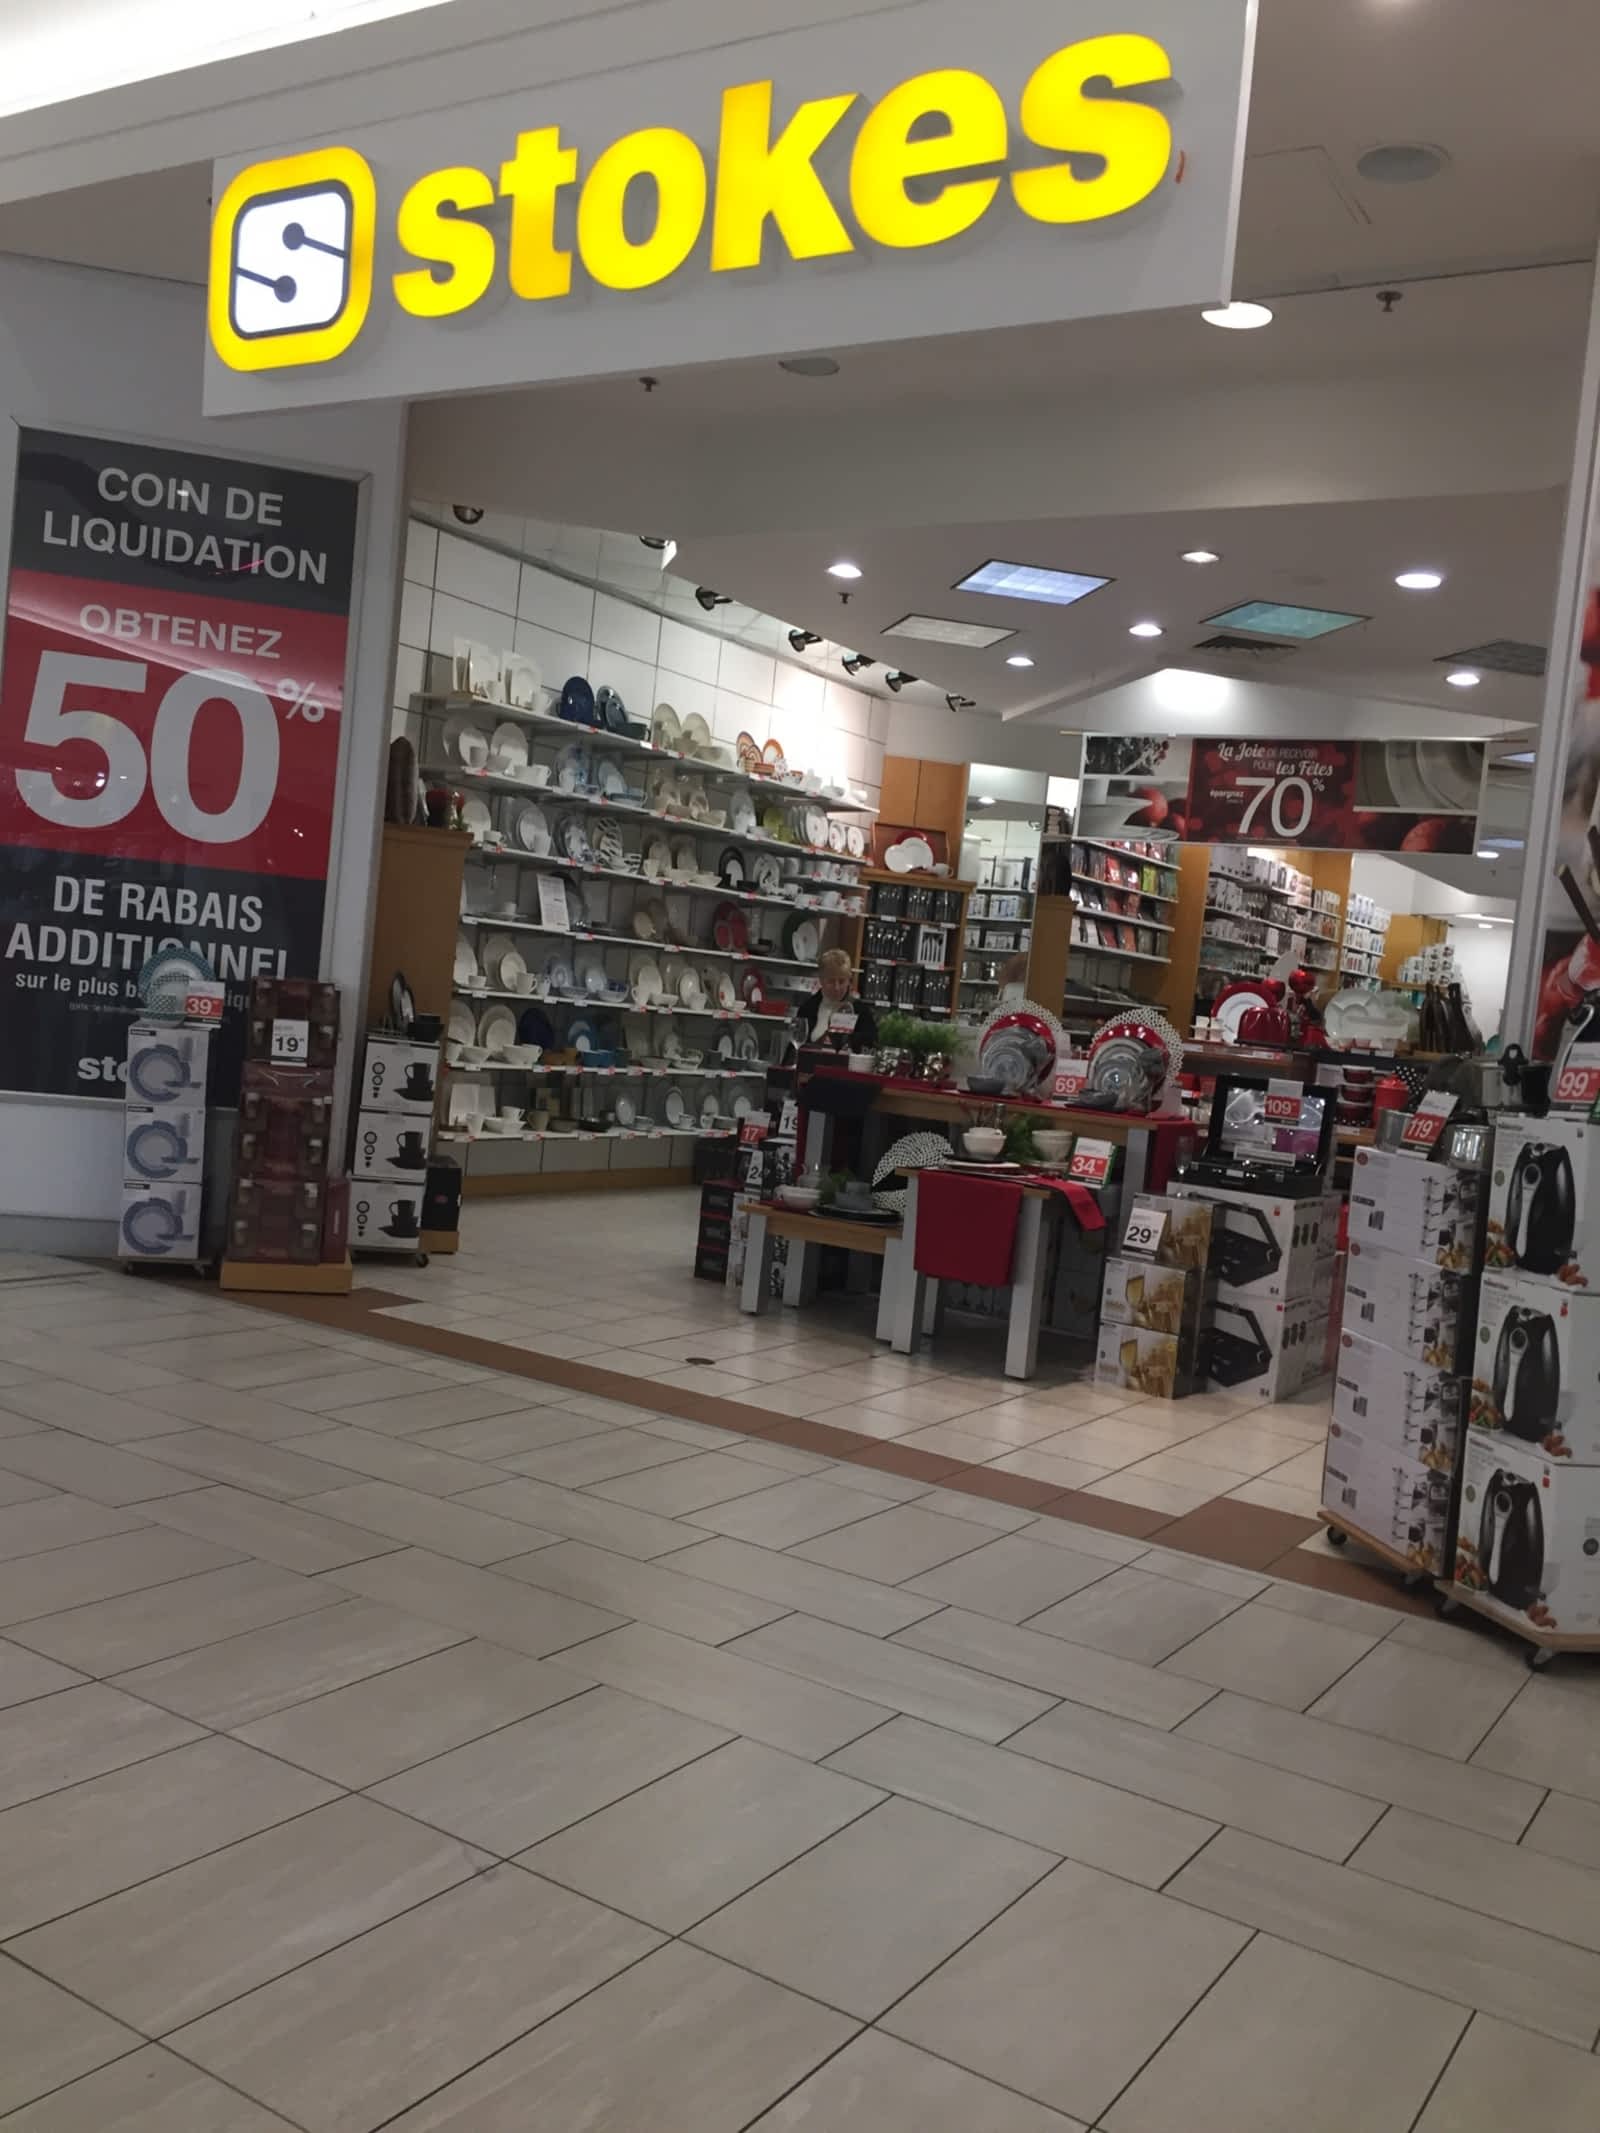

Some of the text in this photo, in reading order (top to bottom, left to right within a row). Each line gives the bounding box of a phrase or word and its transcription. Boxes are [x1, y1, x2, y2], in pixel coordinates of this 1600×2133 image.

[393, 33, 1172, 317] stokes
[98, 467, 284, 527] COIN DE
[43, 510, 327, 584] LIQUIDATION
[80, 604, 282, 658] OBTENEZ
[1218, 742, 1233, 761] La
[1235, 742, 1265, 760] Joie
[1276, 761, 1295, 775] les
[53, 875, 263, 932] DE RABAIS
[15, 973, 48, 988] sur
[54, 973, 72, 991] le
[78, 976, 119, 997] plus
